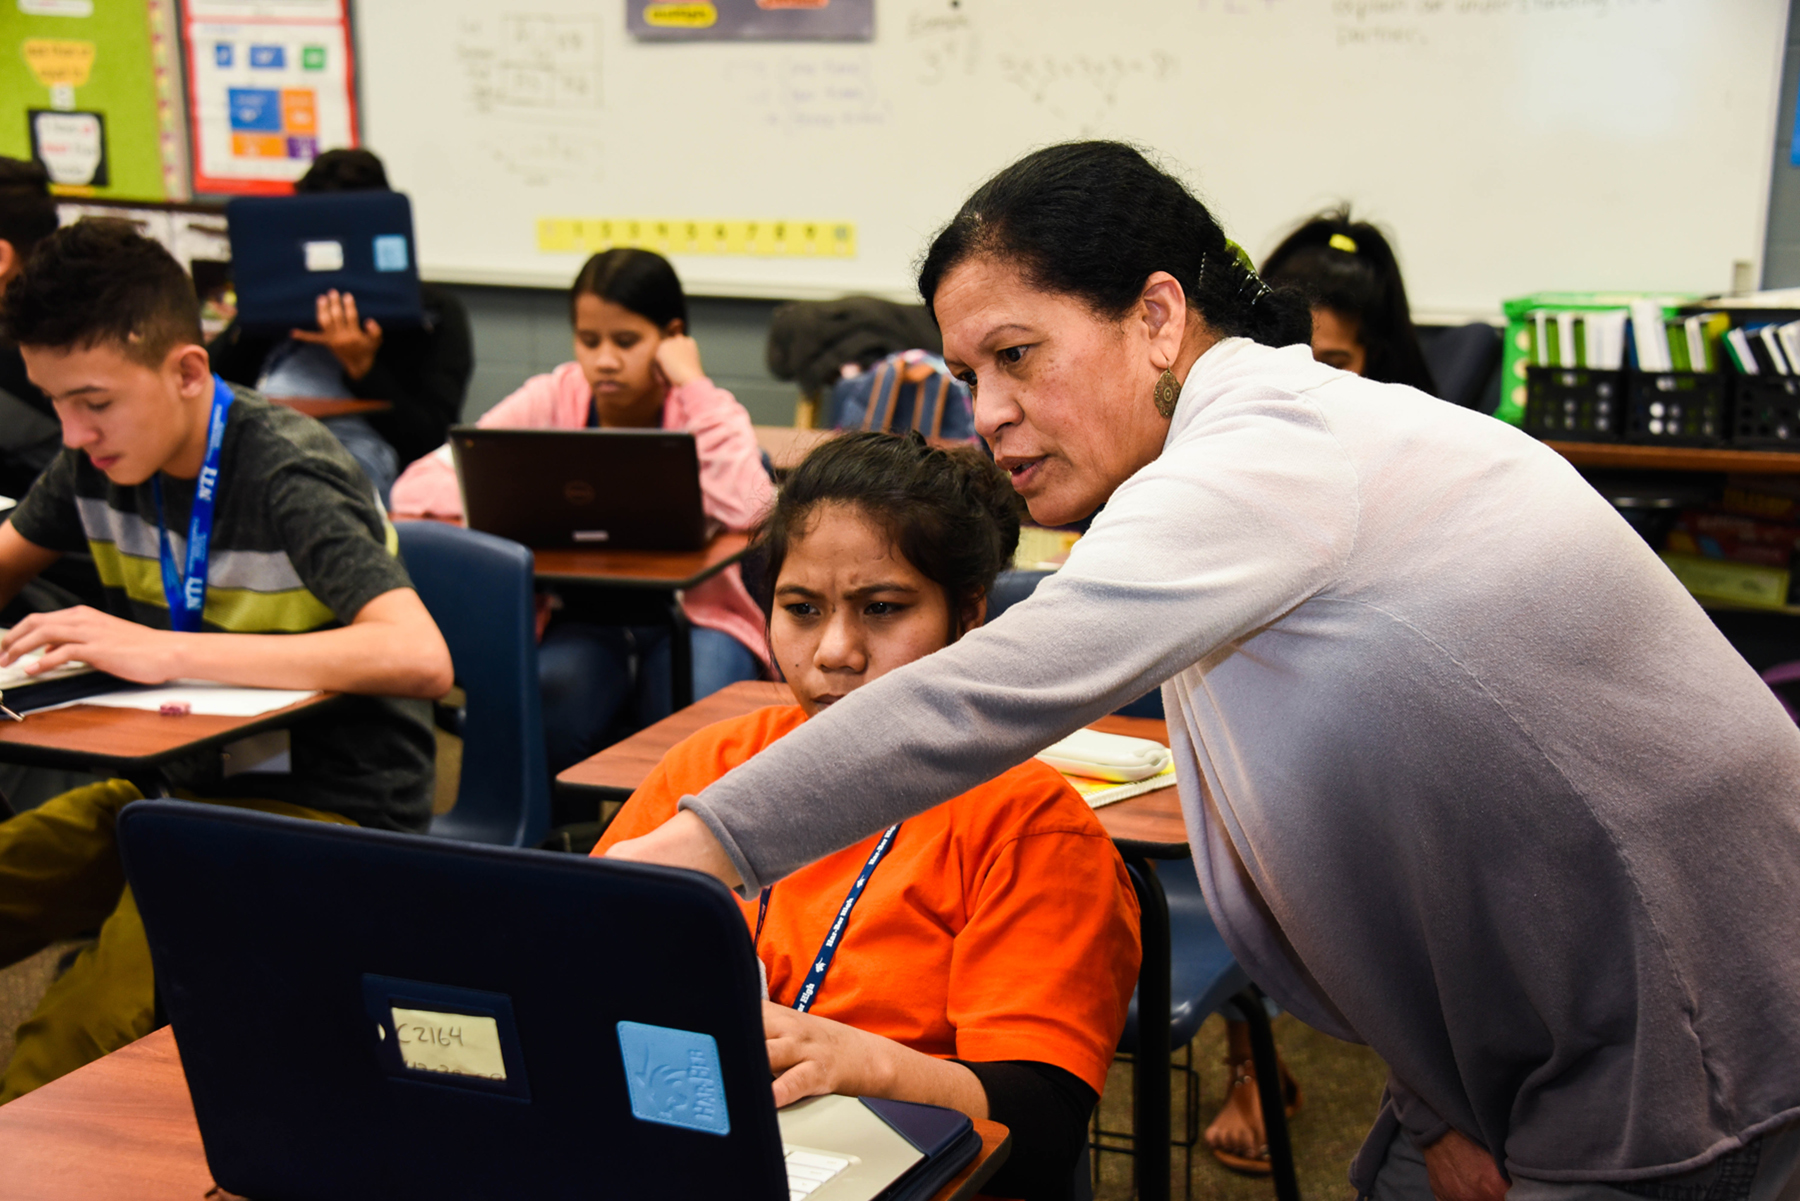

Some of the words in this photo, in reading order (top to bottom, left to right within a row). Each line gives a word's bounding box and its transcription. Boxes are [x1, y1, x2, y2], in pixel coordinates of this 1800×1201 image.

[825, 916, 844, 947] Har-Ber
[840, 897, 854, 916] High
[799, 983, 815, 1004] High
